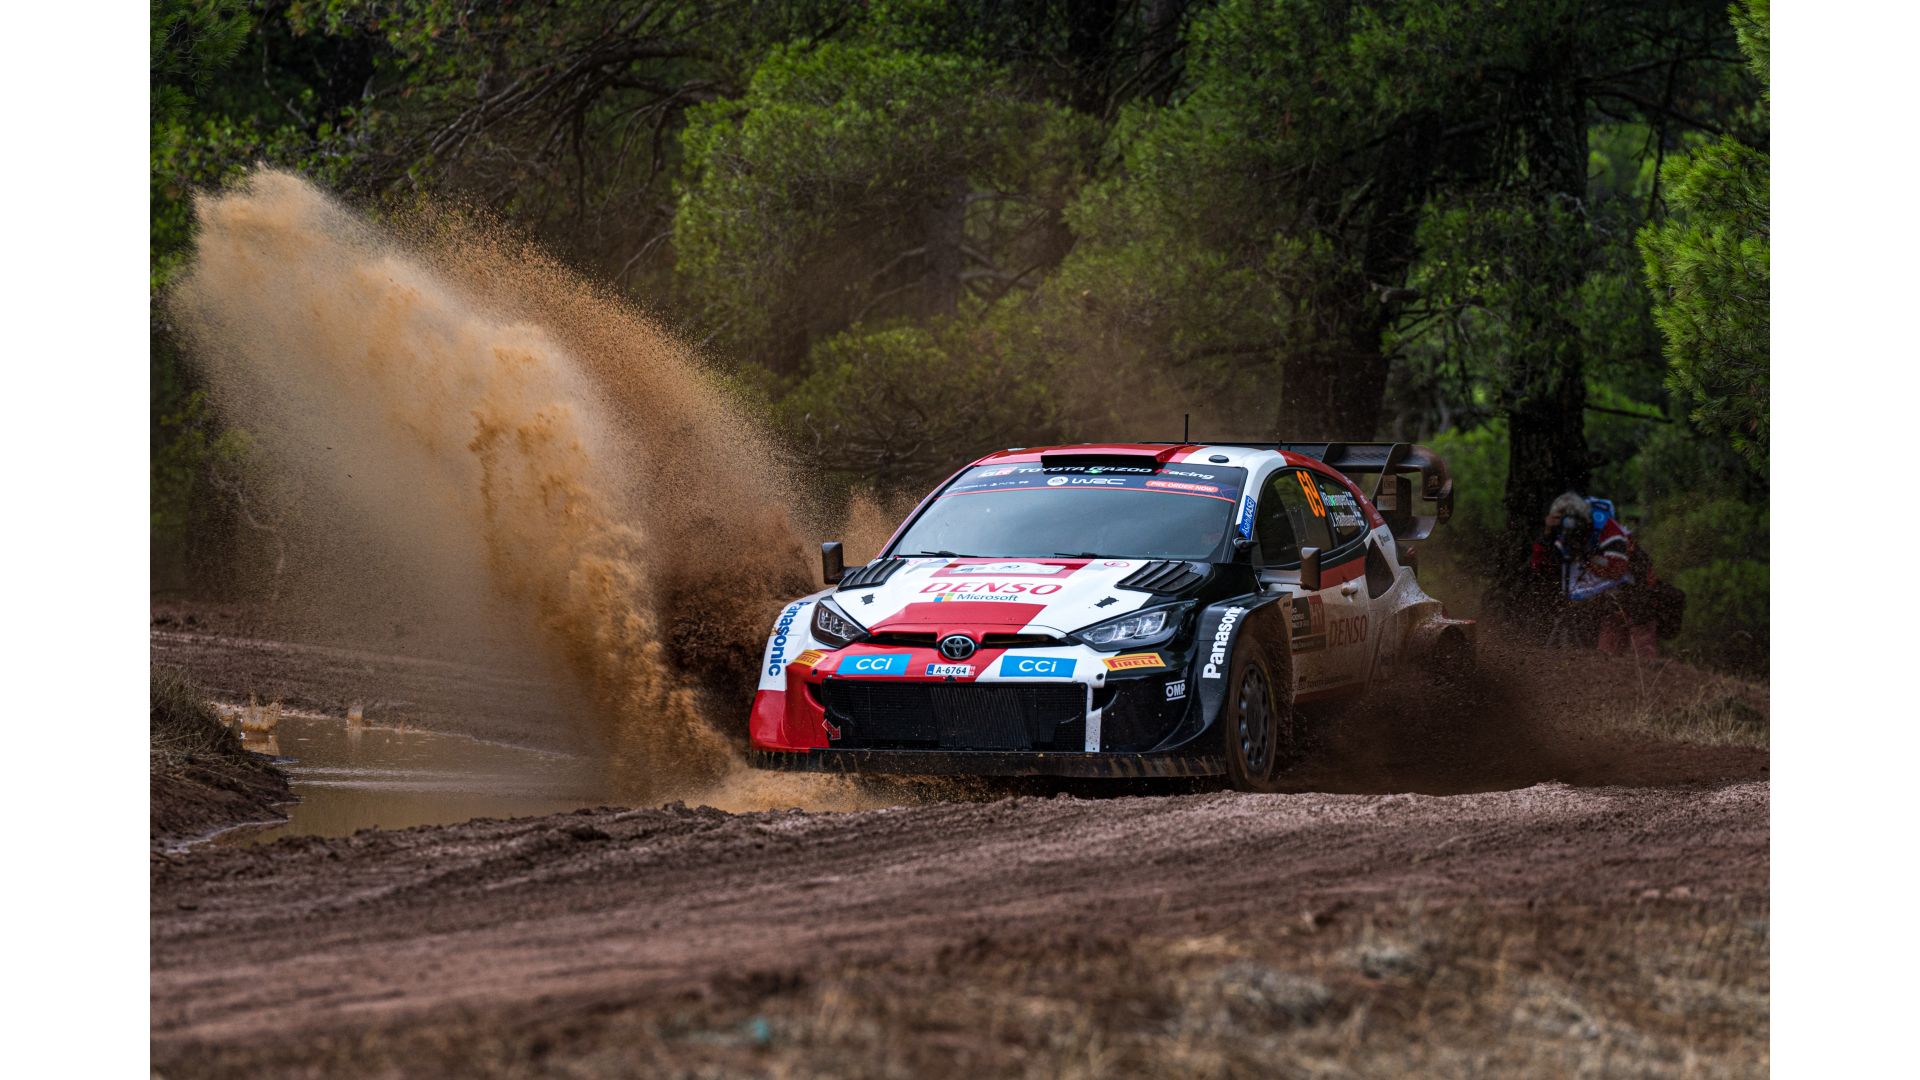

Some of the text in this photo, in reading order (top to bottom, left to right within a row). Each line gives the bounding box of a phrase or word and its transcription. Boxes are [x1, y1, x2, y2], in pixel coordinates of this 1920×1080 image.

[1018, 466, 1085, 474] TOYOTA
[1155, 468, 1215, 480] Racing
[1167, 482, 1194, 490] ORDER
[1296, 470, 1326, 518] 69
[918, 582, 1063, 596] DENSO
[956, 593, 1018, 602] Microsoft
[1329, 615, 1367, 648] DENSO
[768, 601, 812, 677] Panasonic
[1108, 656, 1160, 669] PIRELLI
[935, 666, 967, 675] A-6764
[1165, 682, 1186, 698] OMP
